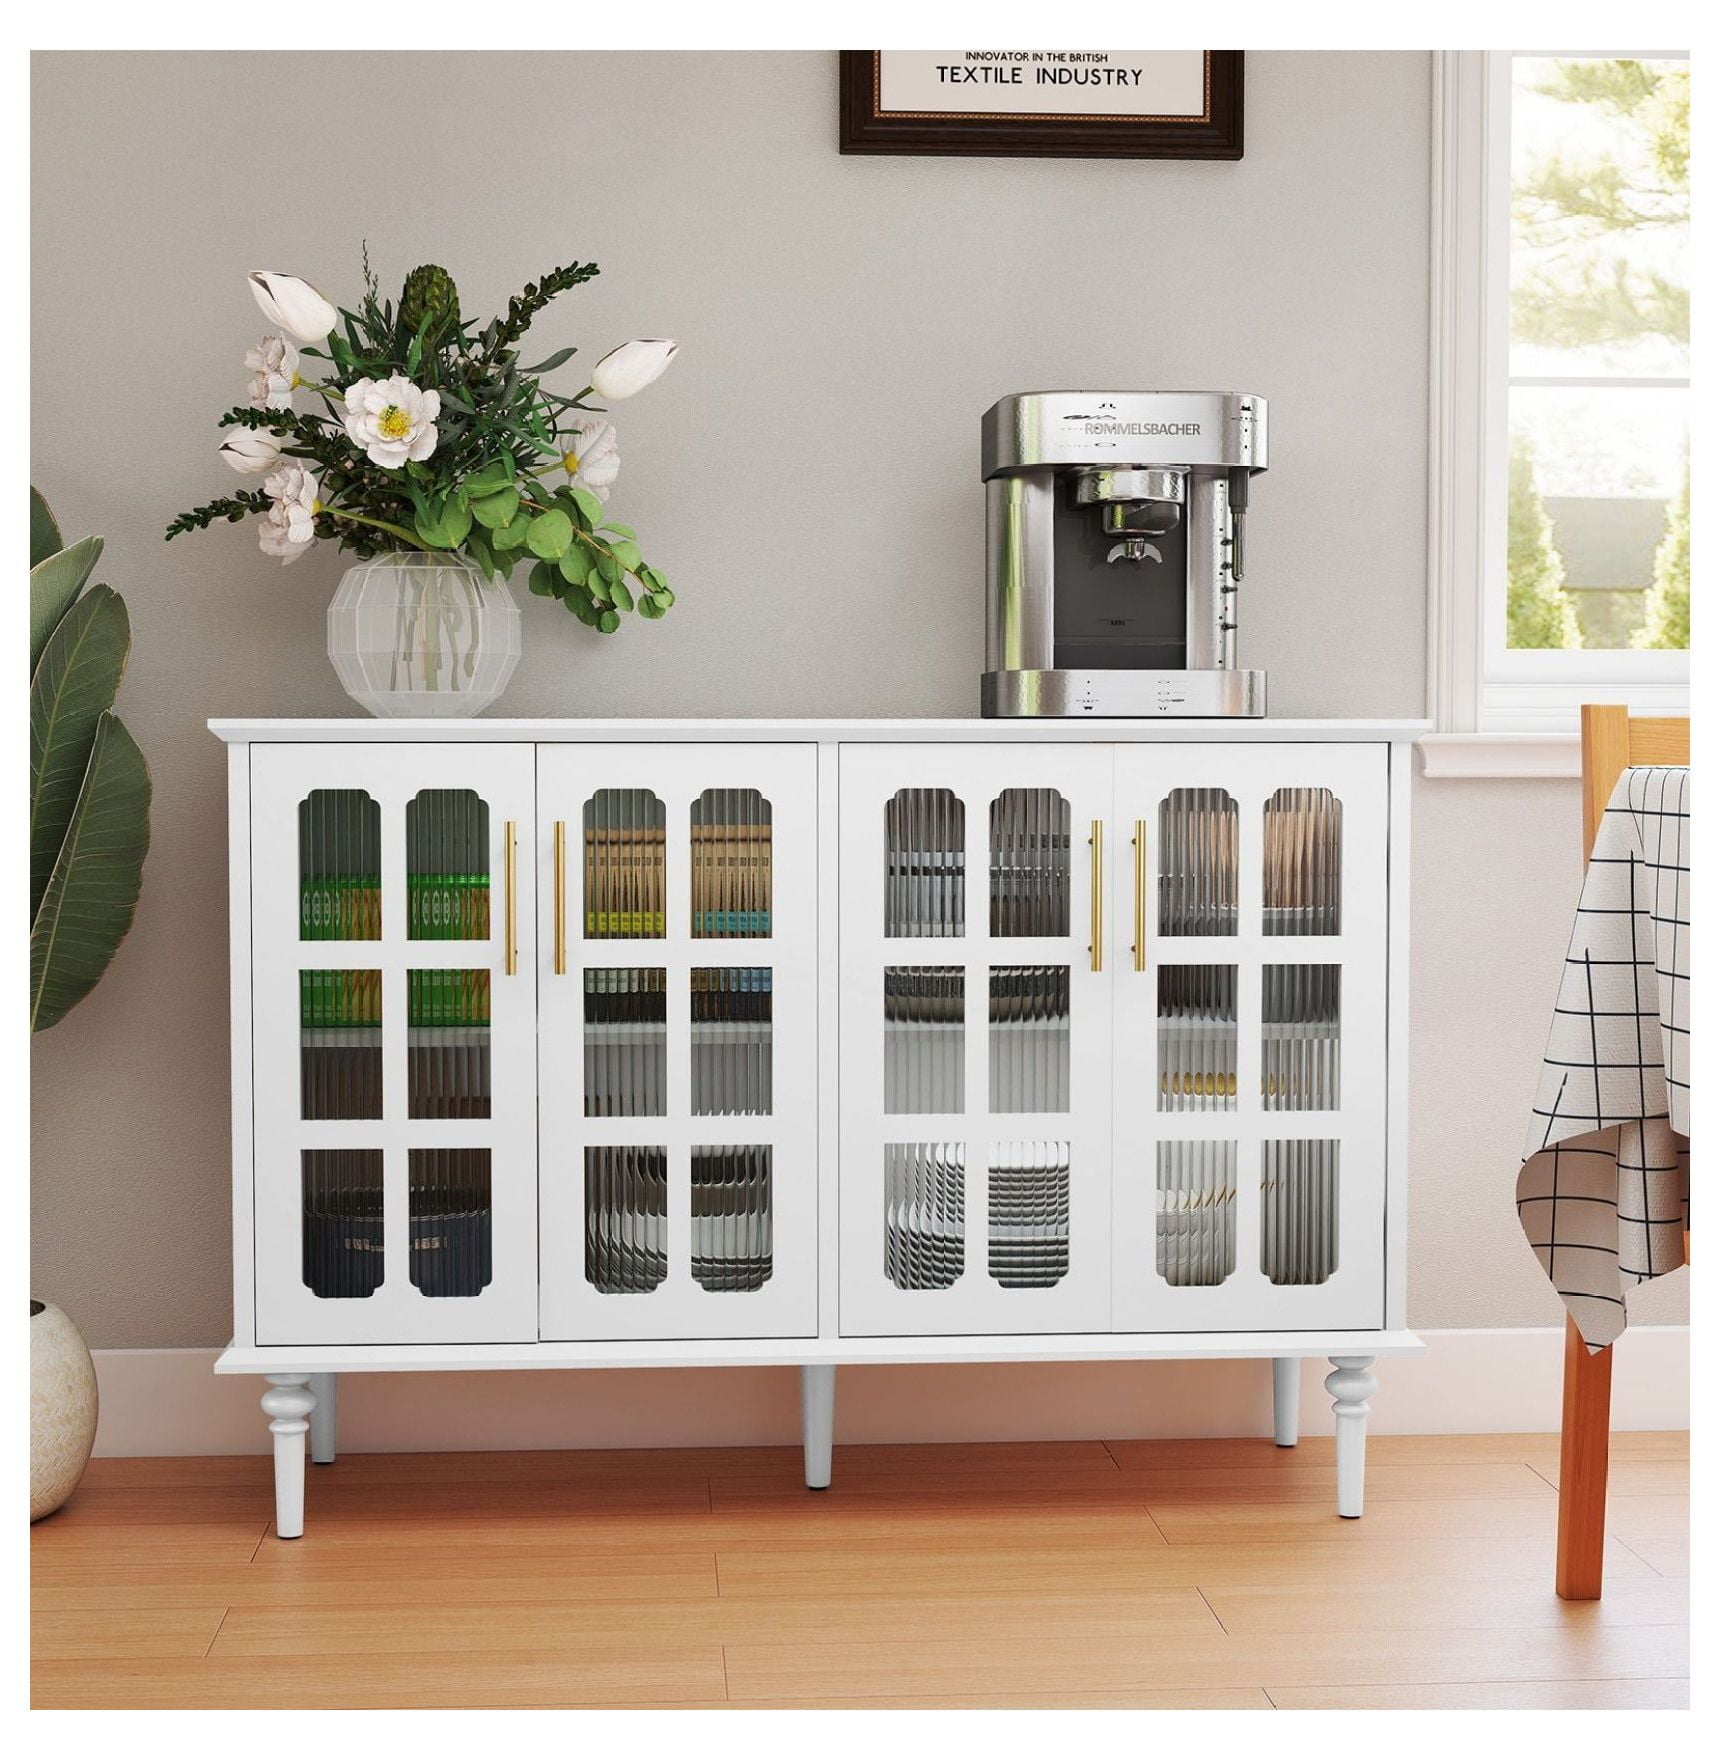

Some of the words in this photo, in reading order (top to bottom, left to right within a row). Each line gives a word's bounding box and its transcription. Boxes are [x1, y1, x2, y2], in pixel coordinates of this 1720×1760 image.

[965, 51, 1029, 62] INNOVATOR
[1032, 52, 1044, 62] IN
[1046, 52, 1067, 63] THE
[1069, 52, 1109, 63] BRITISH
[936, 66, 1023, 84] TEXTILE
[1036, 67, 1143, 86] INDUSTRY
[1085, 422, 1201, 436] ROMMELSBACHER
